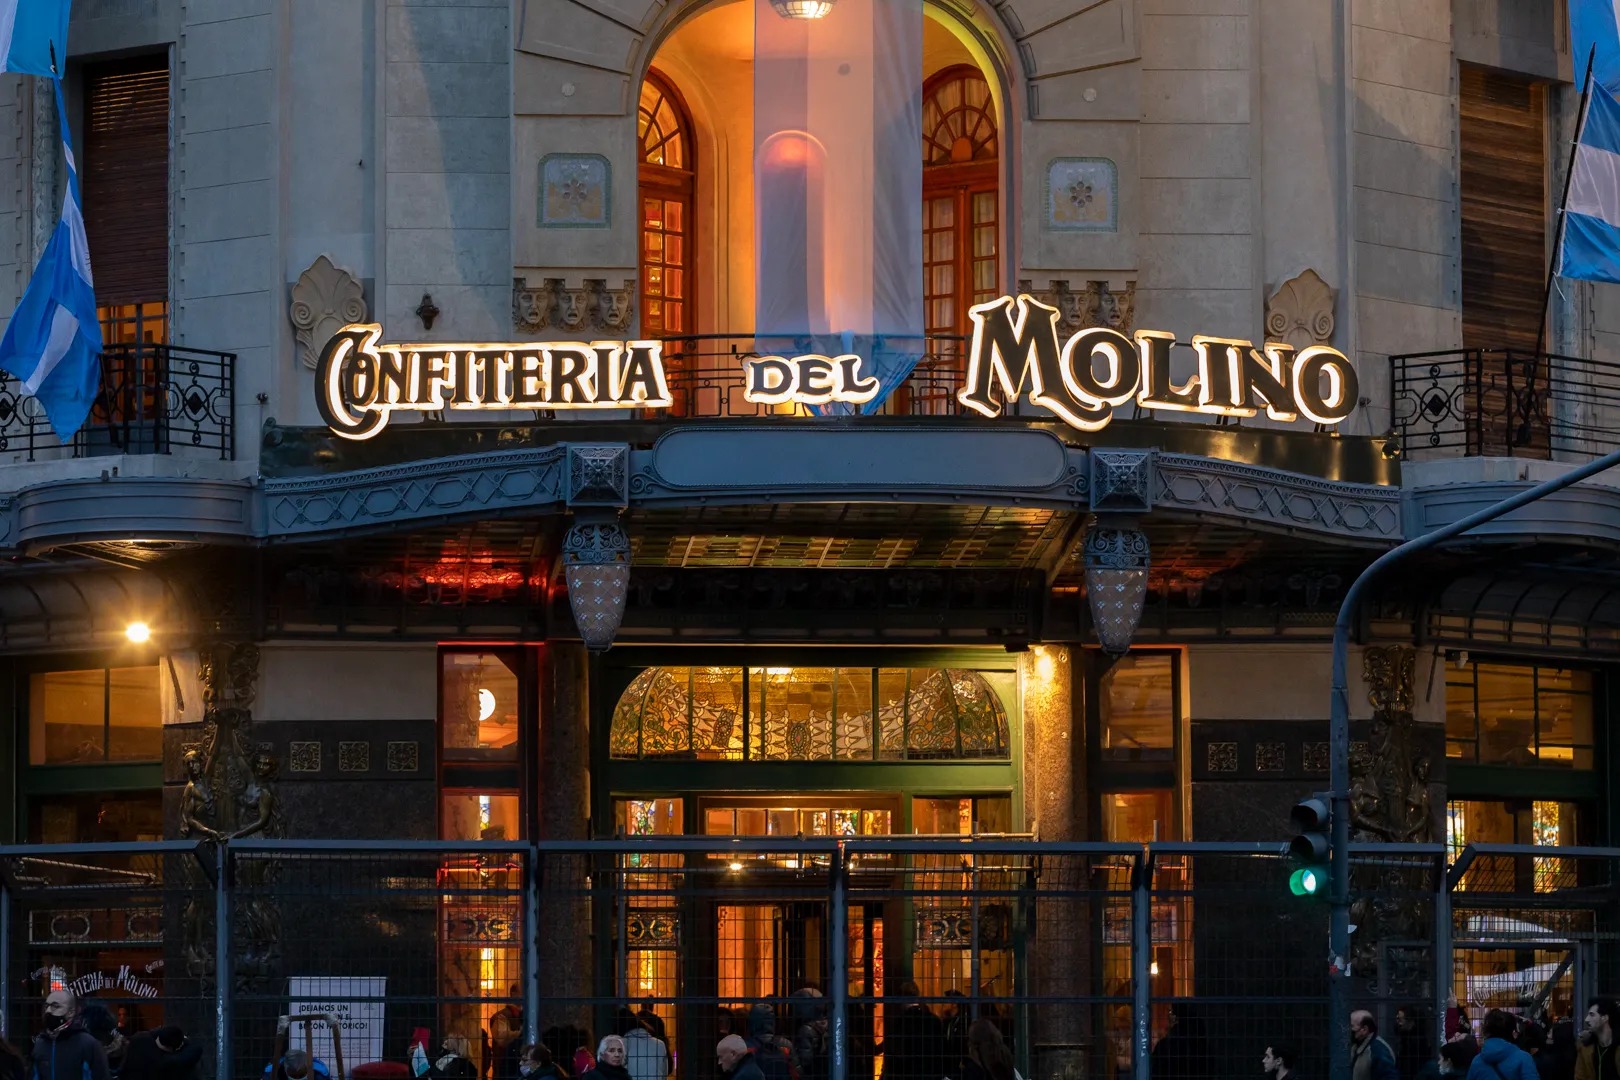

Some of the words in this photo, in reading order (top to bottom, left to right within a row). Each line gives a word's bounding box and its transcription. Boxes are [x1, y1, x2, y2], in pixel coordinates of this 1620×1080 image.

[314, 325, 672, 440] CONFITERIA
[744, 354, 880, 404] DEL
[958, 295, 1359, 431] MOLINO
[337, 1004, 348, 1012] UN
